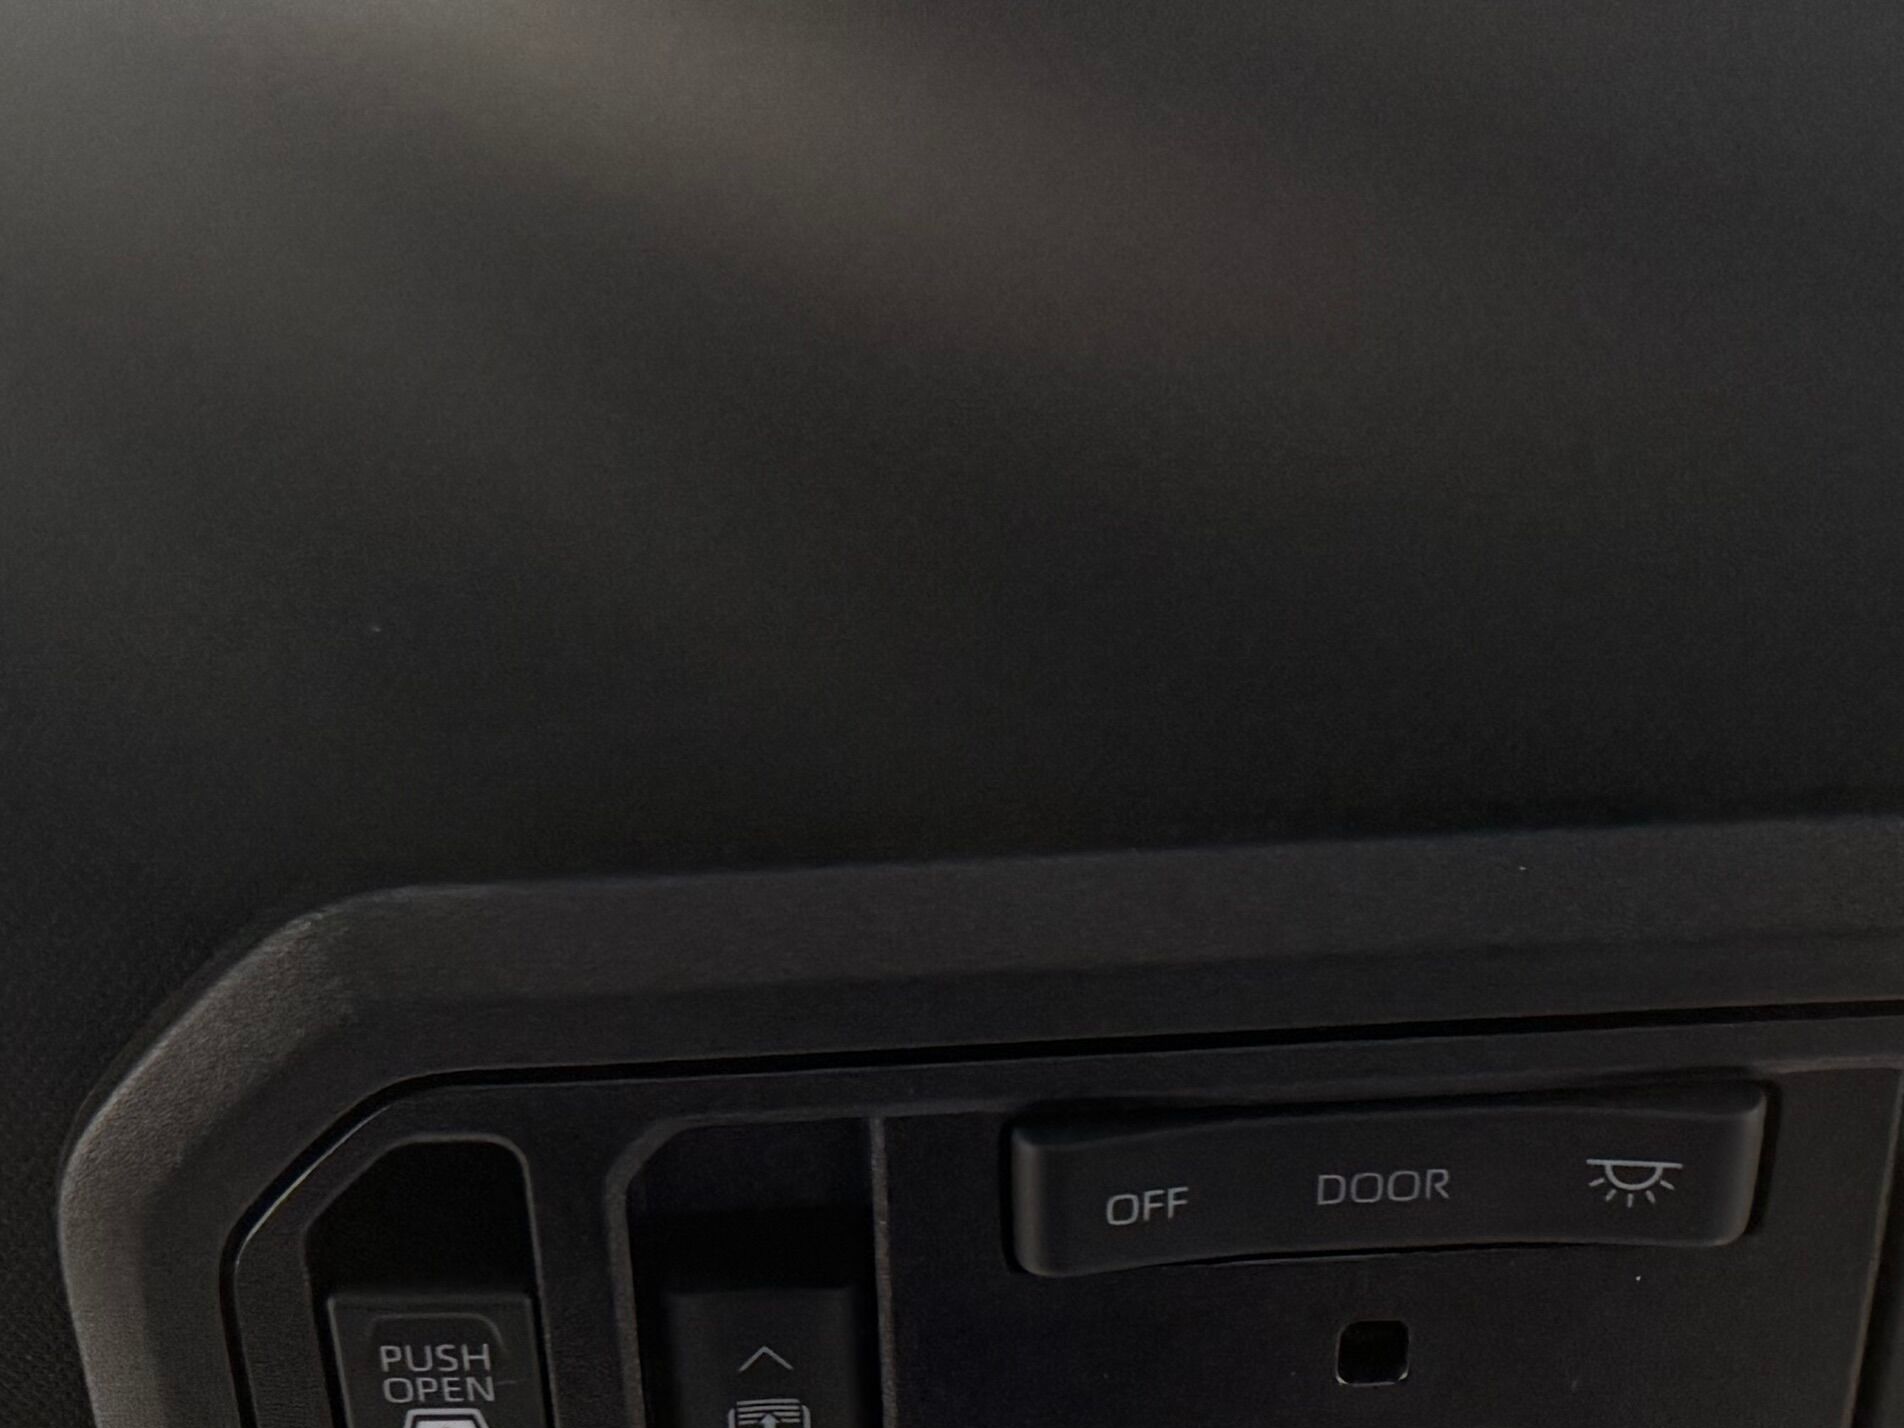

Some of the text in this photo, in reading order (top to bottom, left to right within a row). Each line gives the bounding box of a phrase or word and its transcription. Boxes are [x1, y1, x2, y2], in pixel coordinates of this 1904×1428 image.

[1106, 1168, 1451, 1226] OFF DOOR
[379, 1343, 491, 1372] PUSH
[382, 1376, 495, 1403] OPEN
